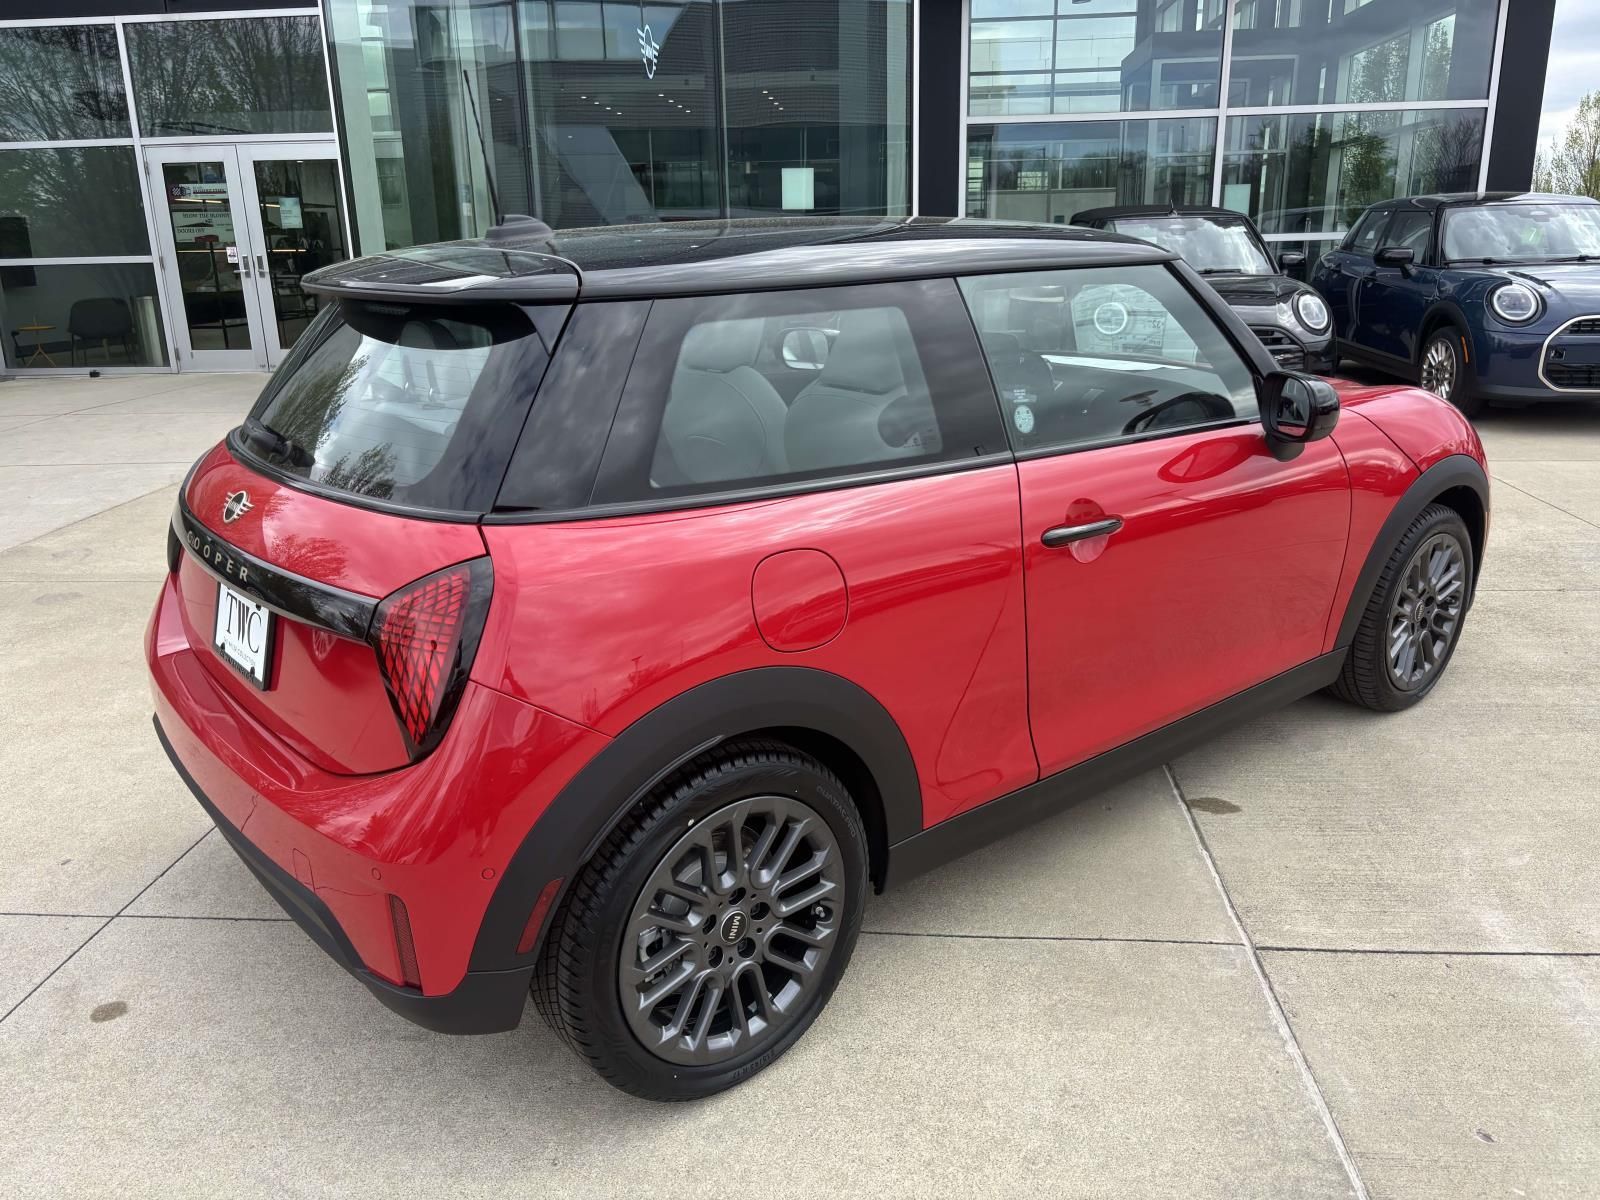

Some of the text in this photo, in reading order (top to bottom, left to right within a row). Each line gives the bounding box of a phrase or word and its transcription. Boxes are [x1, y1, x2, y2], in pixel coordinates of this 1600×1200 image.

[187, 530, 249, 582] COOPER
[225, 591, 262, 653] TWC
[727, 915, 741, 939] MINI
